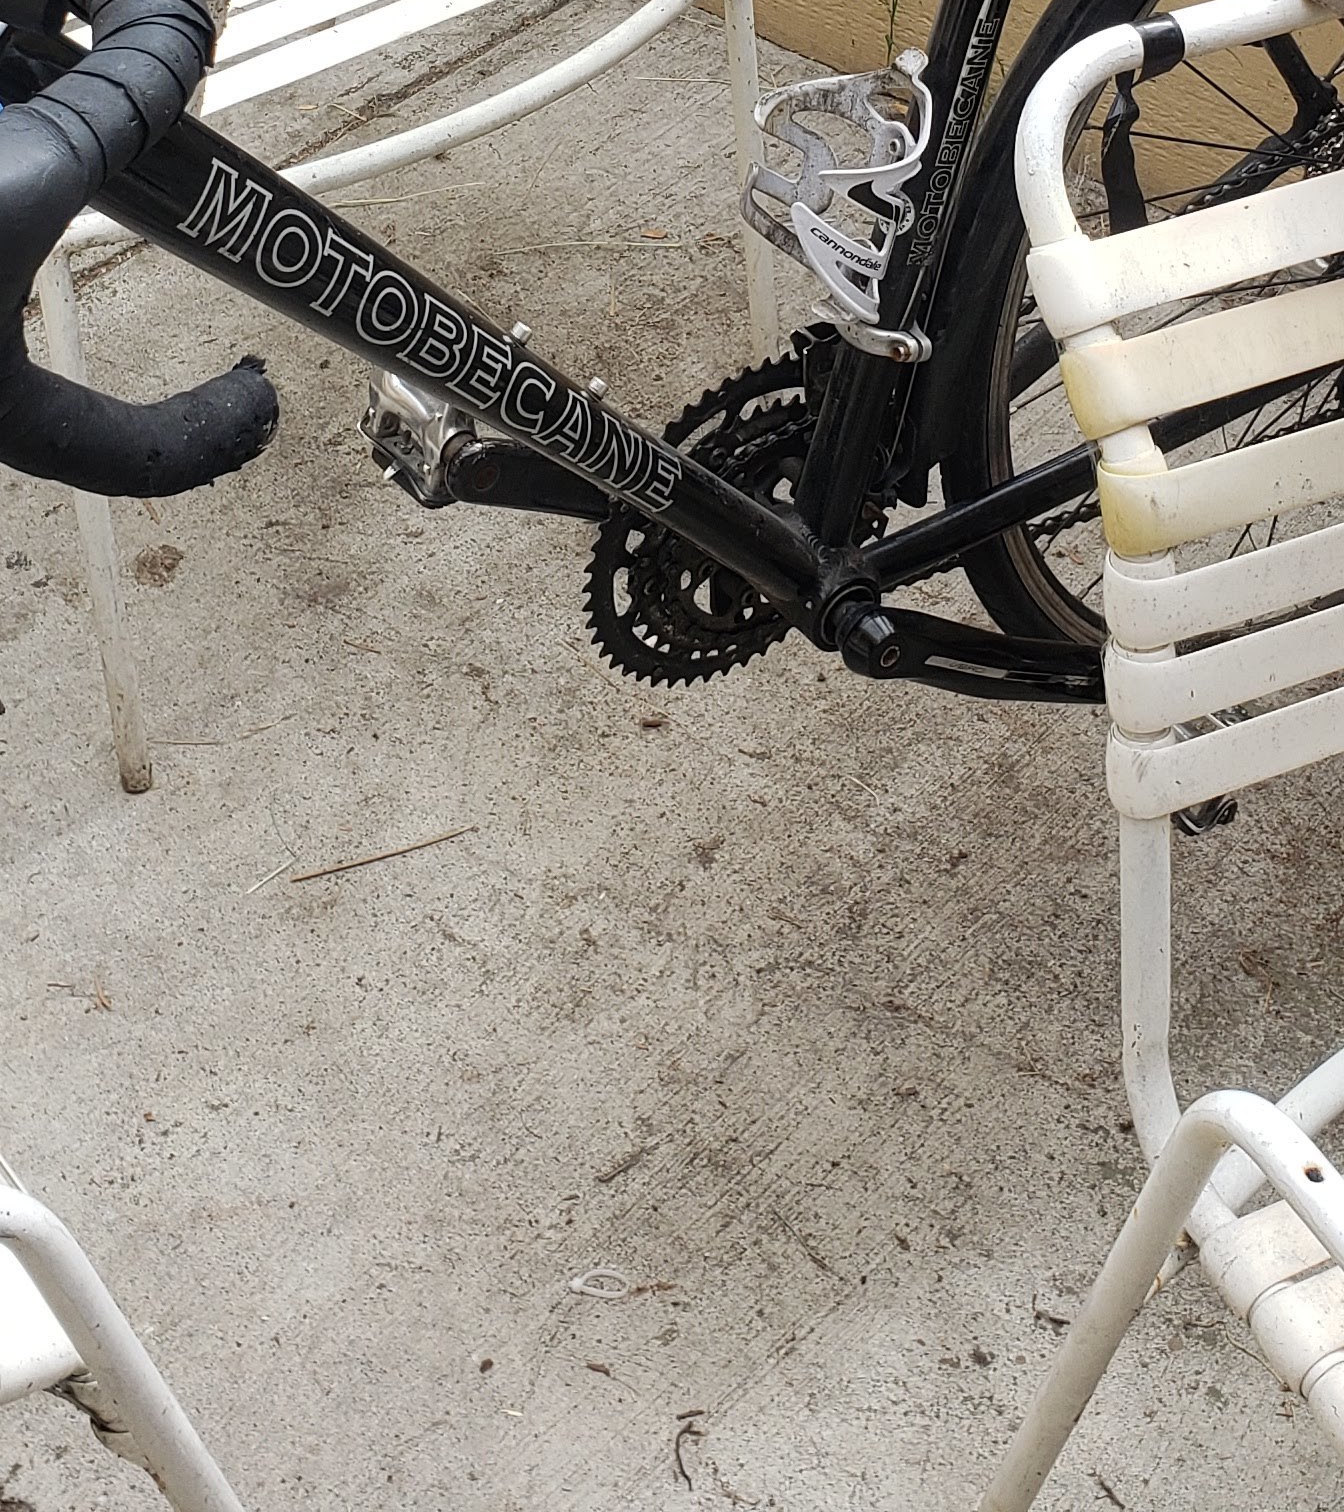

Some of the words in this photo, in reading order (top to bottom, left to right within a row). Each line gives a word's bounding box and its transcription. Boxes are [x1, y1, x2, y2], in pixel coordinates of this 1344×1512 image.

[810, 227, 882, 271] cannondale
[907, 18, 1000, 266] MOTOBECANE
[178, 156, 682, 513] MOTOBECANE
